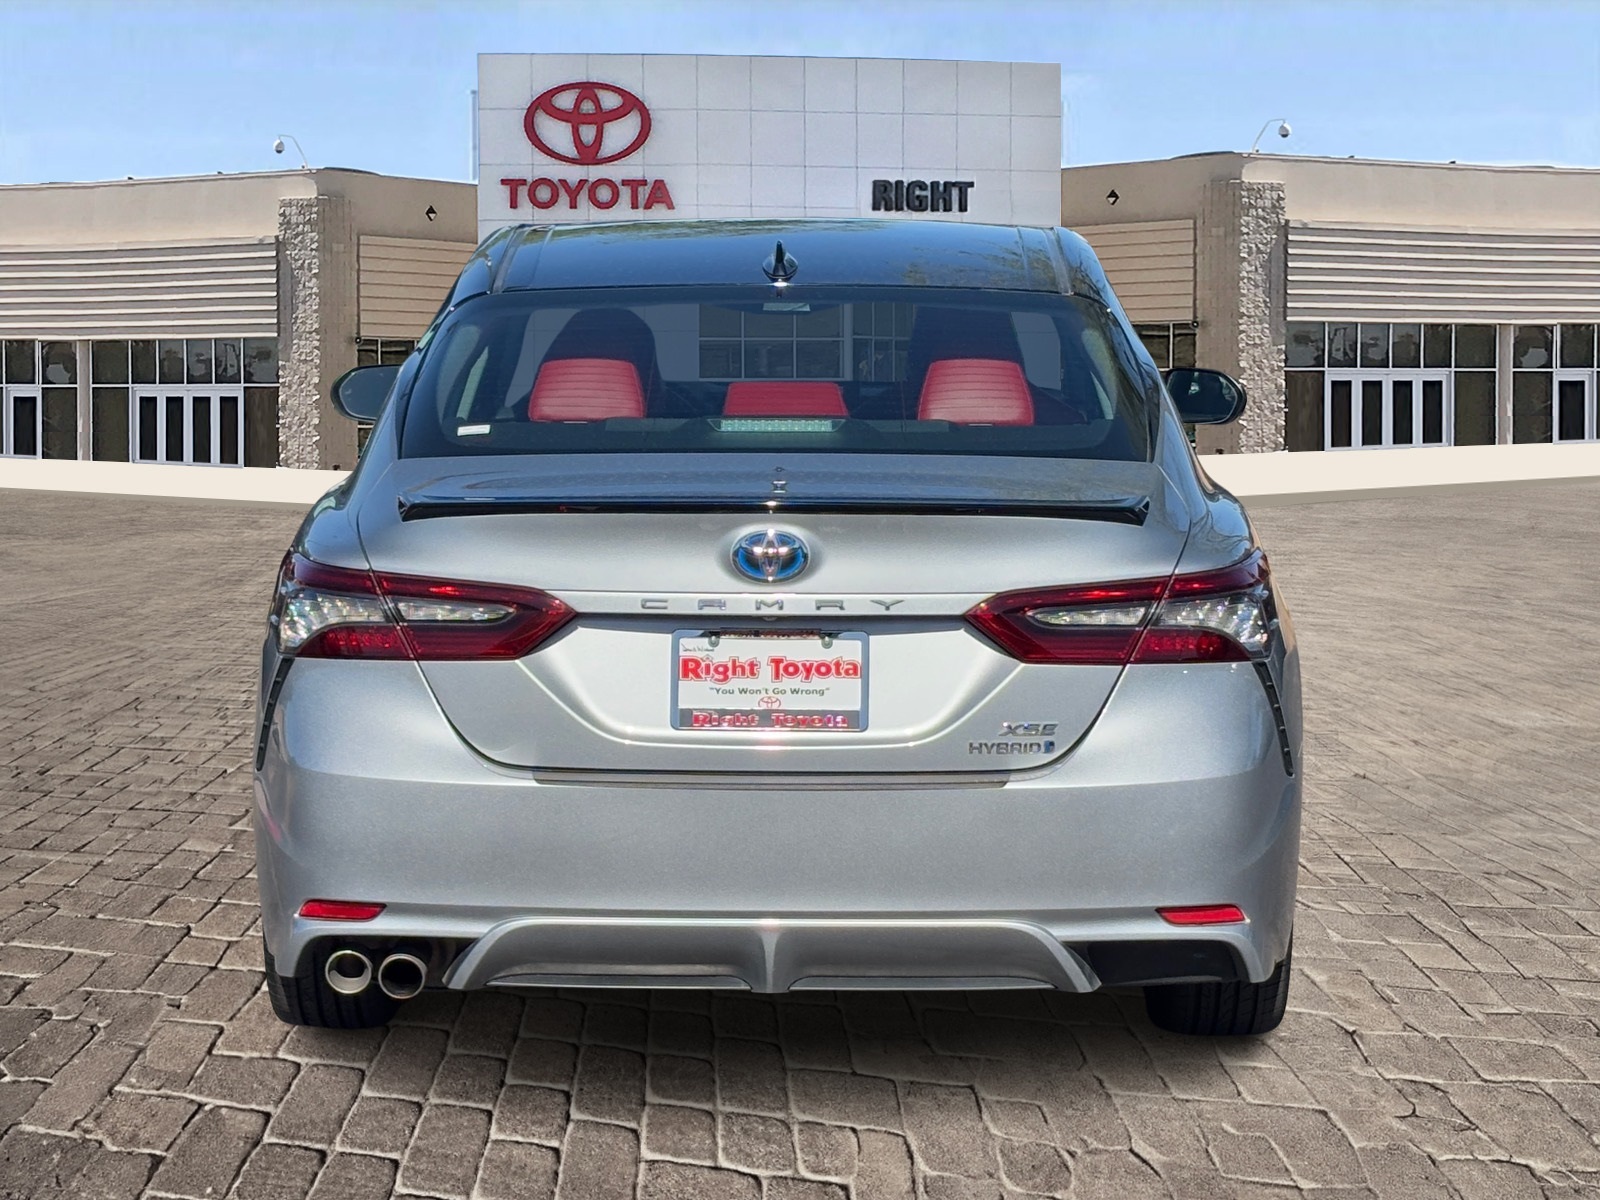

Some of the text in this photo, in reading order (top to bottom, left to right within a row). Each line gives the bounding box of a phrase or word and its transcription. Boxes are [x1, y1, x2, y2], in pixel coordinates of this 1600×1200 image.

[500, 178, 675, 210] TOYOTA
[871, 179, 975, 212] RIGHT
[640, 599, 904, 611] CAMRY
[680, 656, 861, 684] Right Toyota
[738, 687, 770, 695] Won't
[772, 687, 787, 695] Go
[693, 713, 848, 728] Right Toyota
[999, 723, 1058, 736] XSE
[968, 742, 1041, 755] HYBRID
